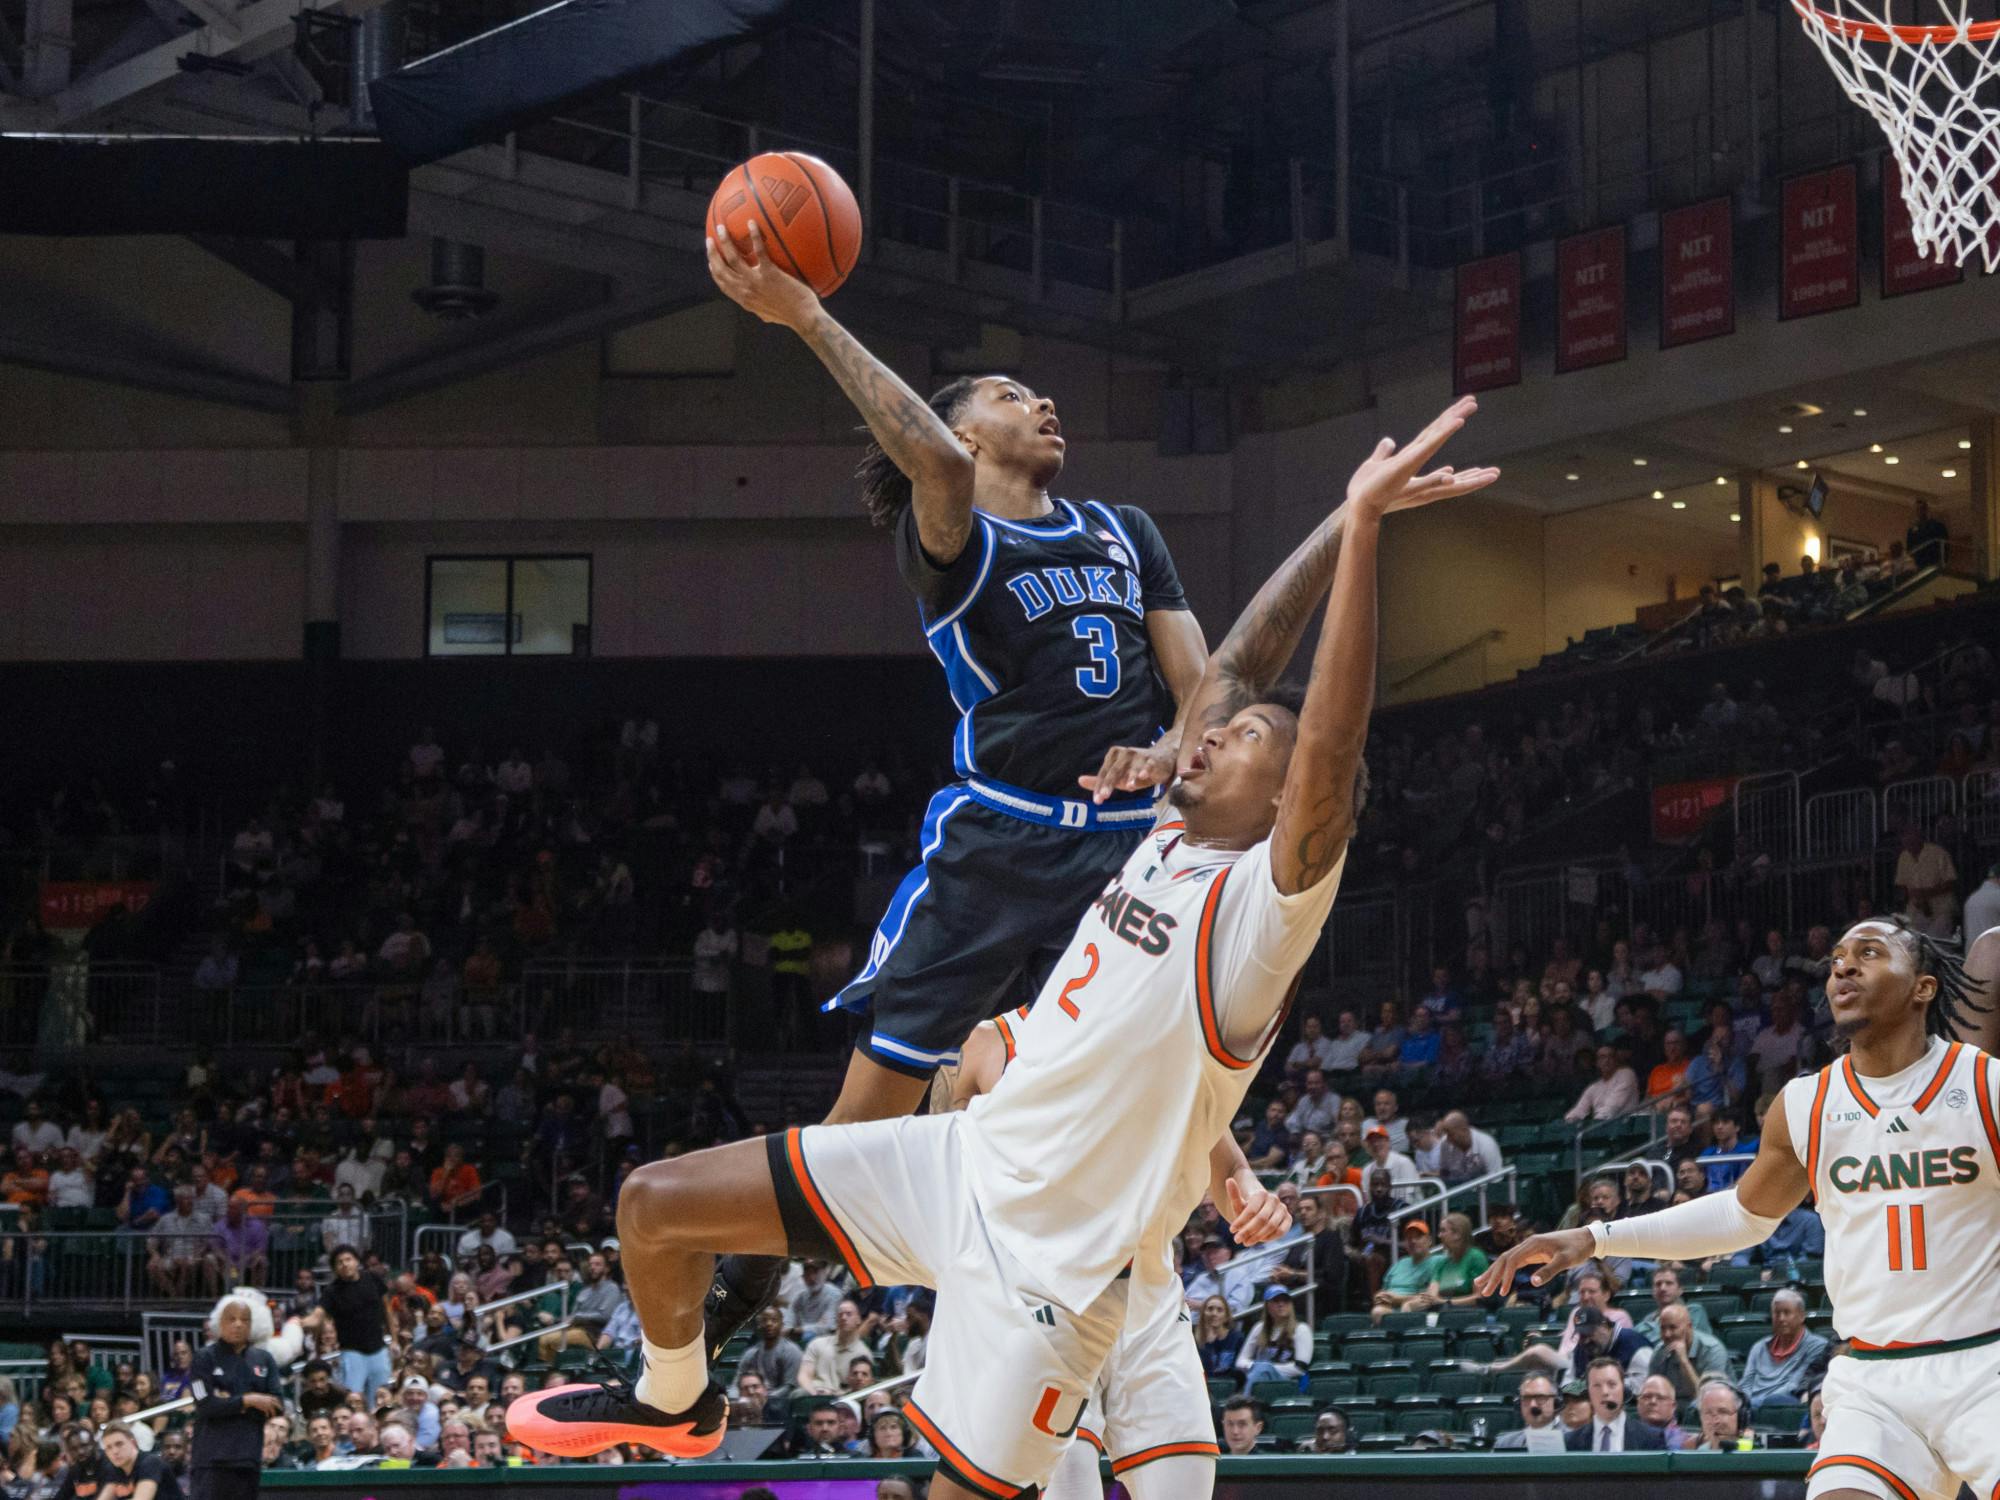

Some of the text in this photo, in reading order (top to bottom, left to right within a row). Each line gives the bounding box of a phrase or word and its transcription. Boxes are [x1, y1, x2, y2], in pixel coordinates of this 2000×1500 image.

[1802, 204, 1837, 230] NIT
[1680, 234, 1713, 261] NIT
[1575, 263, 1607, 286] NIT
[1466, 288, 1510, 312] NCAA
[1006, 567, 1144, 621] DUKE
[1072, 614, 1120, 699] 3
[1060, 801, 1088, 828] D
[1057, 942, 1101, 1022] 2
[1844, 1111, 1862, 1121] 100
[1829, 1146, 1980, 1194] CANES
[1887, 1204, 1928, 1271] 11
[1032, 1385, 1089, 1438] U
